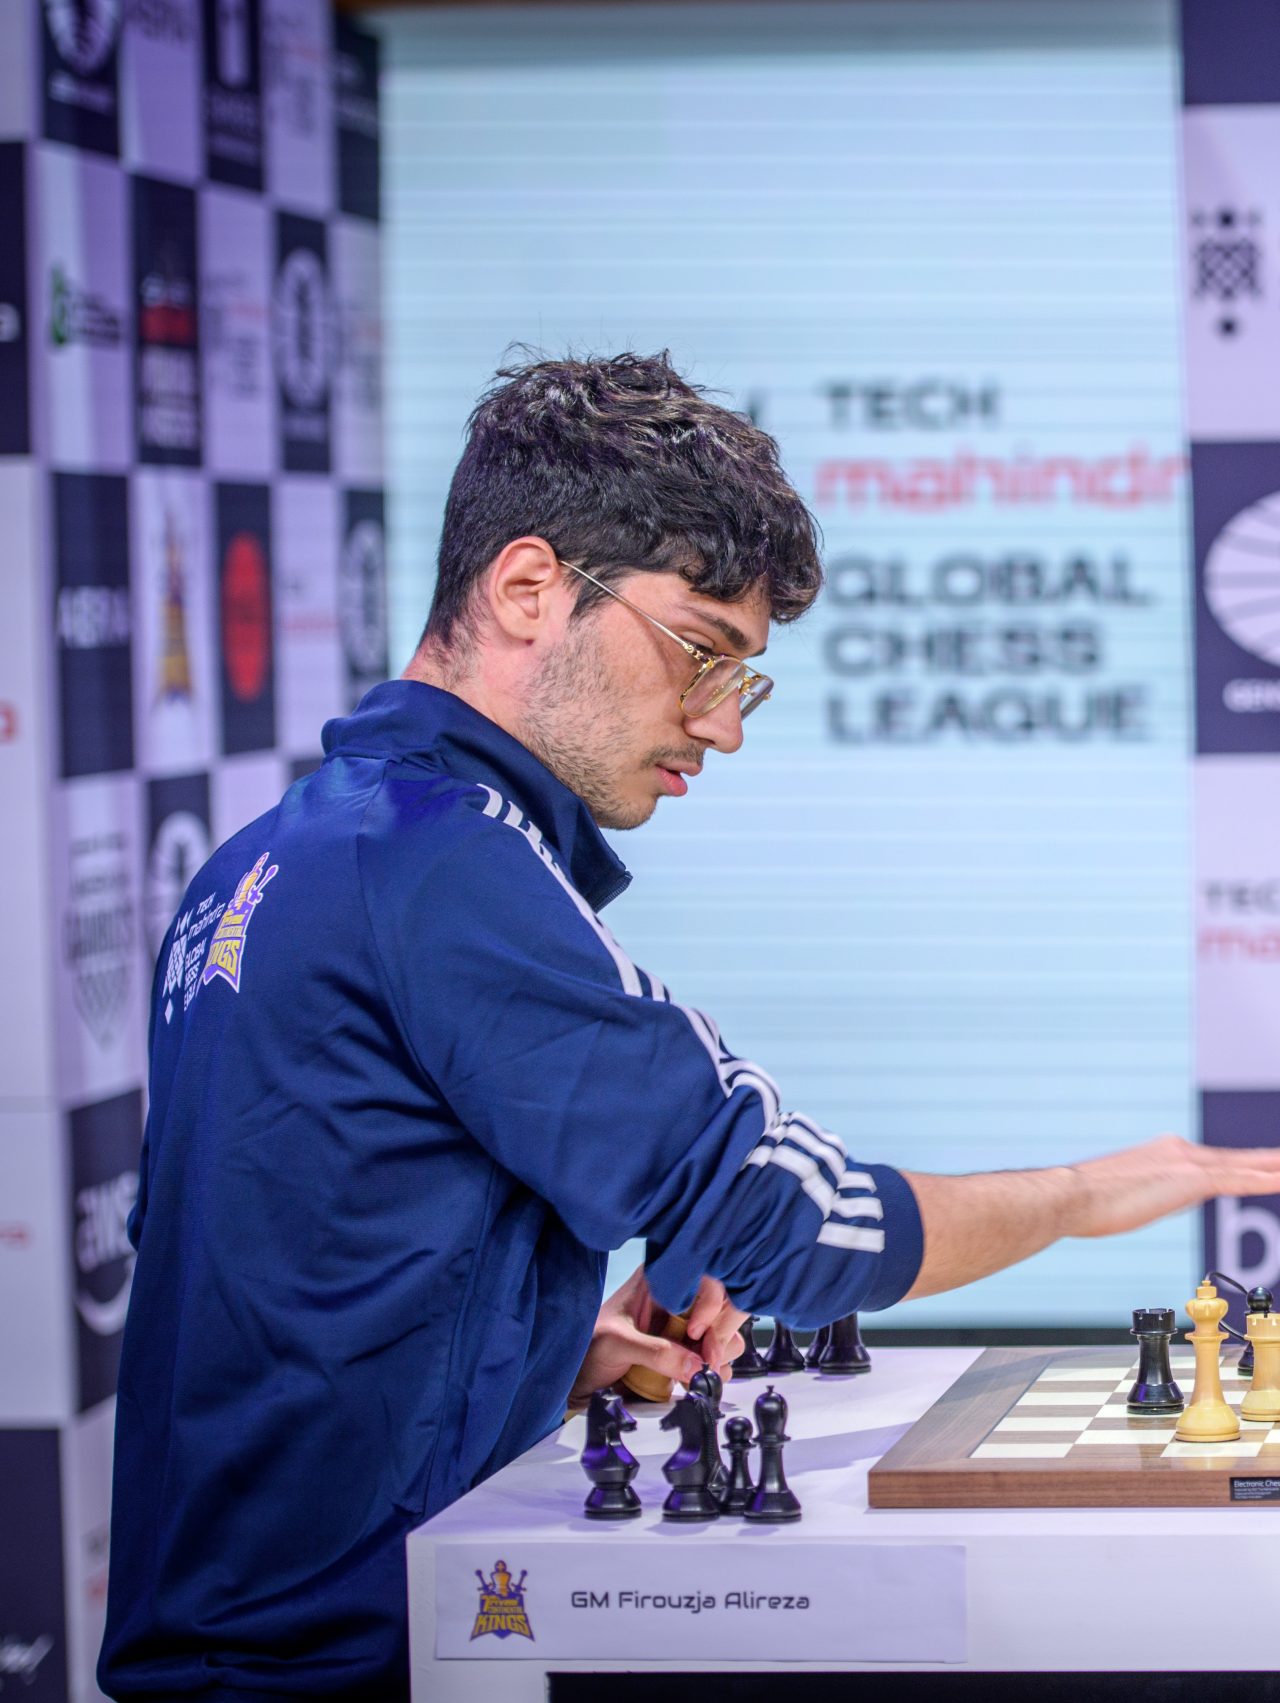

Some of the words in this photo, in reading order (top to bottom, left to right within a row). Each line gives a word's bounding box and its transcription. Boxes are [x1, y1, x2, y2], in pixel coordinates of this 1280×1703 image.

[822, 380, 1000, 430] TECH
[827, 555, 1155, 608] GLOBAL
[825, 622, 1102, 677] CHESS
[826, 687, 1148, 744] LEAGUE
[1233, 1480, 1264, 1488] Electronic
[475, 1614, 530, 1636] KINGS
[571, 1592, 610, 1609] GM
[618, 1591, 716, 1614] Firouzja
[724, 1591, 811, 1609] Alireza
